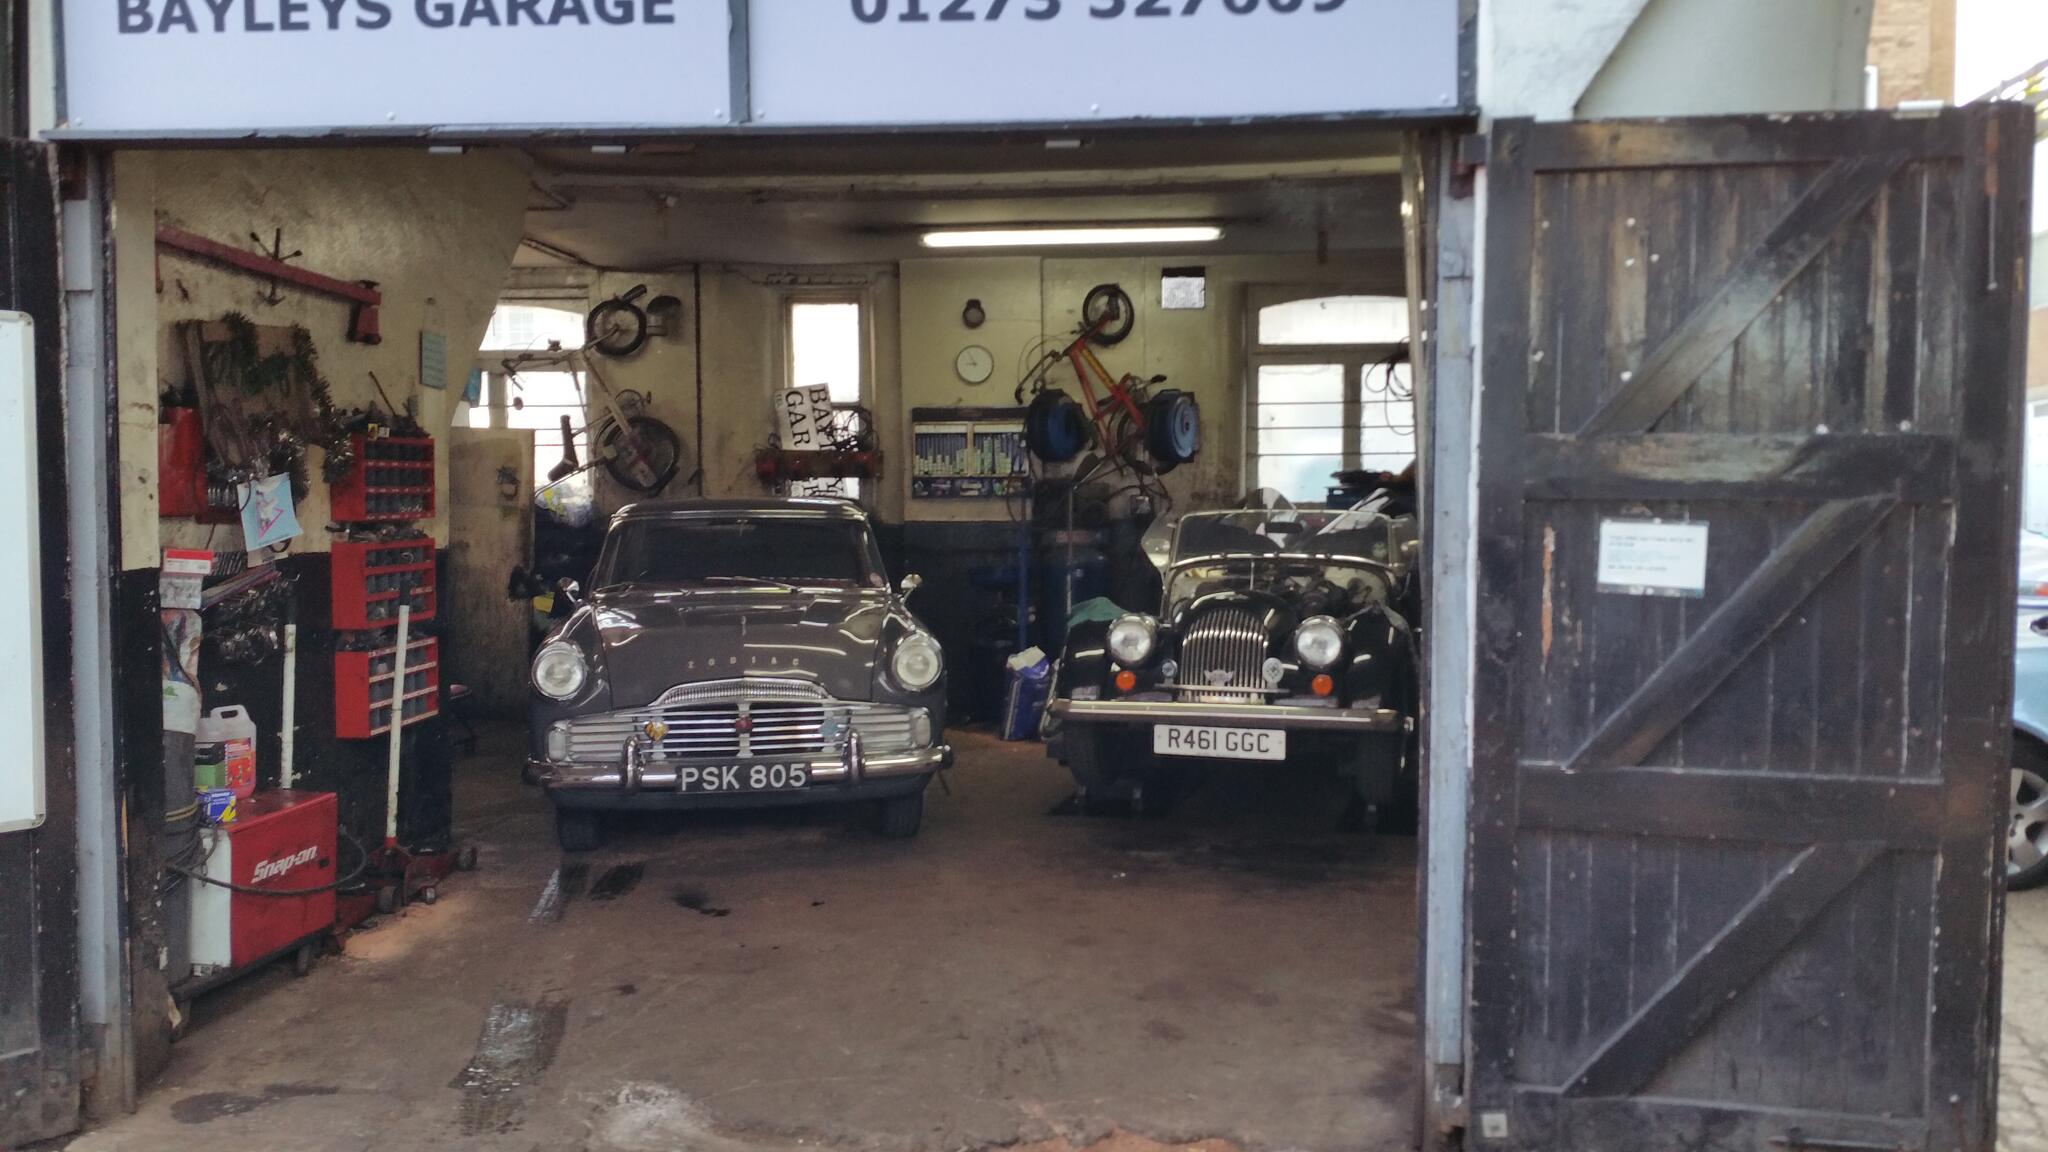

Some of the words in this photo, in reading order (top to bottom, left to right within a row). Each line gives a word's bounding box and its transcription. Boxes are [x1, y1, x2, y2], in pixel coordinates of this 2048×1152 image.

[118, 0, 392, 34] BAYLEYS
[1168, 728, 1217, 750] R461
[1225, 731, 1270, 753] GGC
[681, 765, 740, 791] PSK
[750, 763, 806, 788] 805
[251, 845, 317, 884] Snap-on
